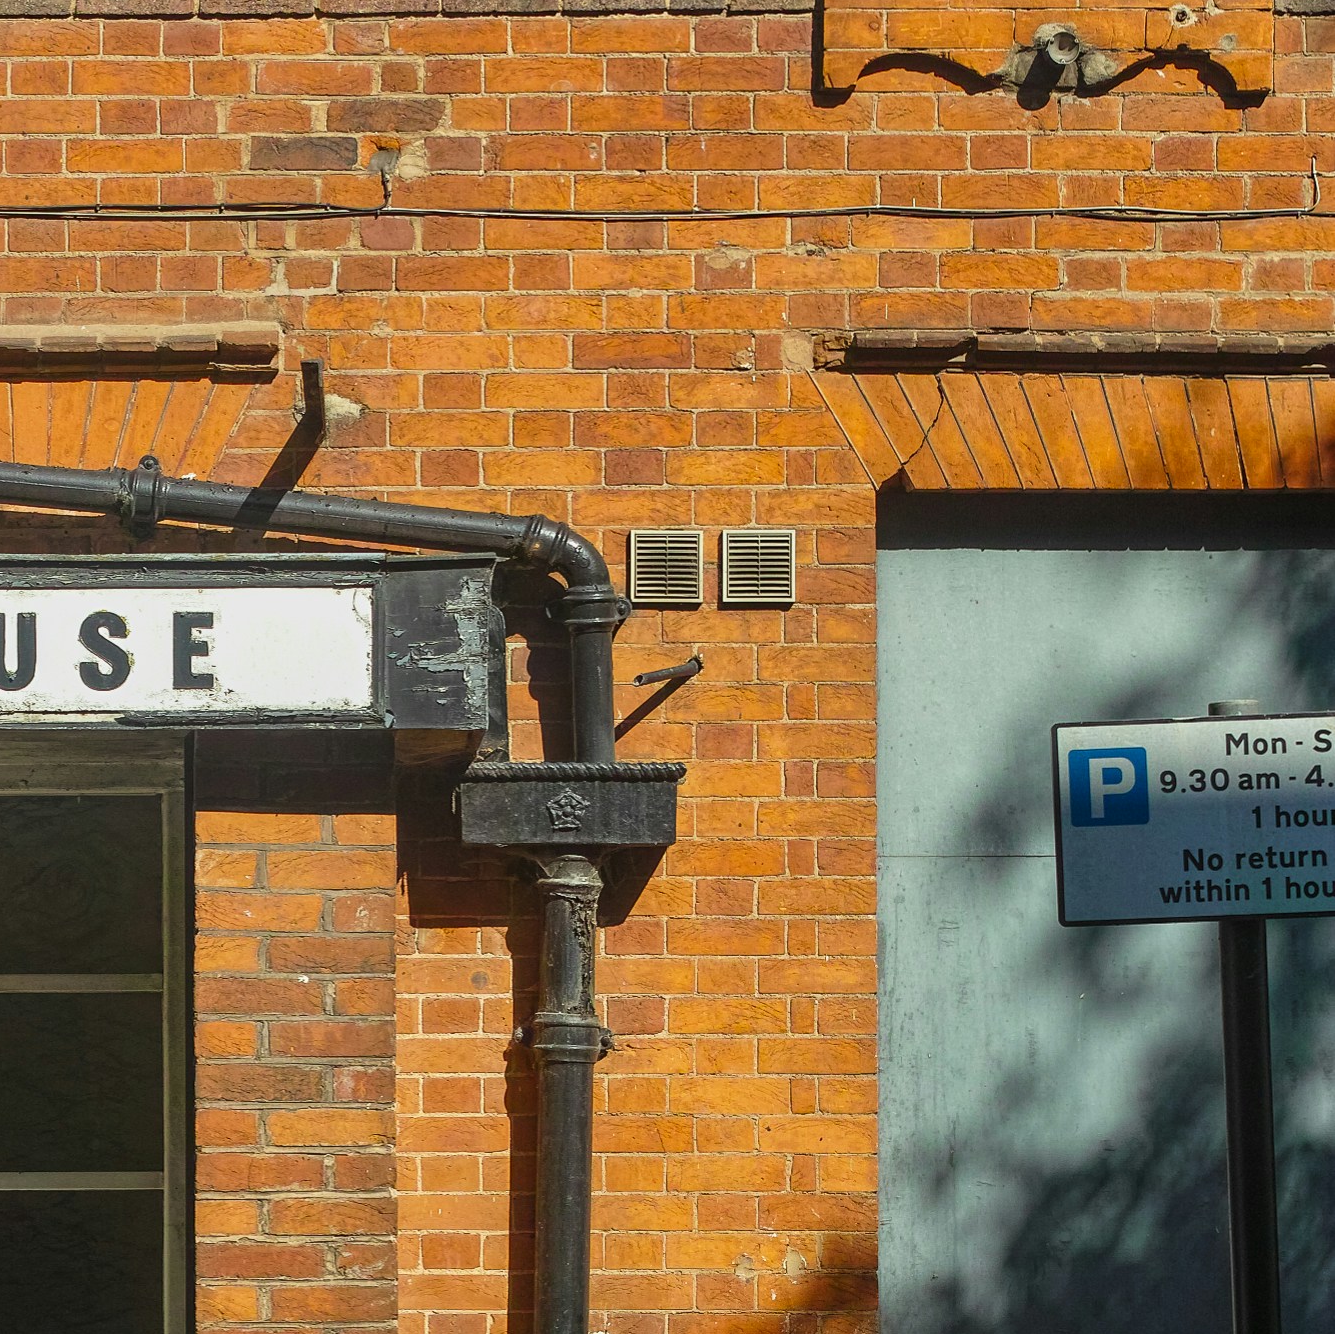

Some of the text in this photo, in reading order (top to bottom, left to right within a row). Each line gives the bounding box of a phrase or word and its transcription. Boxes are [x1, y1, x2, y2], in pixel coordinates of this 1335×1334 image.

[1225, 732, 1287, 757] Mon
[1088, 756, 1136, 819] P
[1159, 768, 1230, 794] 9.30
[1237, 772, 1280, 790] am
[1251, 805, 1262, 829] 1
[1182, 846, 1328, 872] No return
[1159, 878, 1251, 904] within
[1262, 877, 1272, 900] 1
